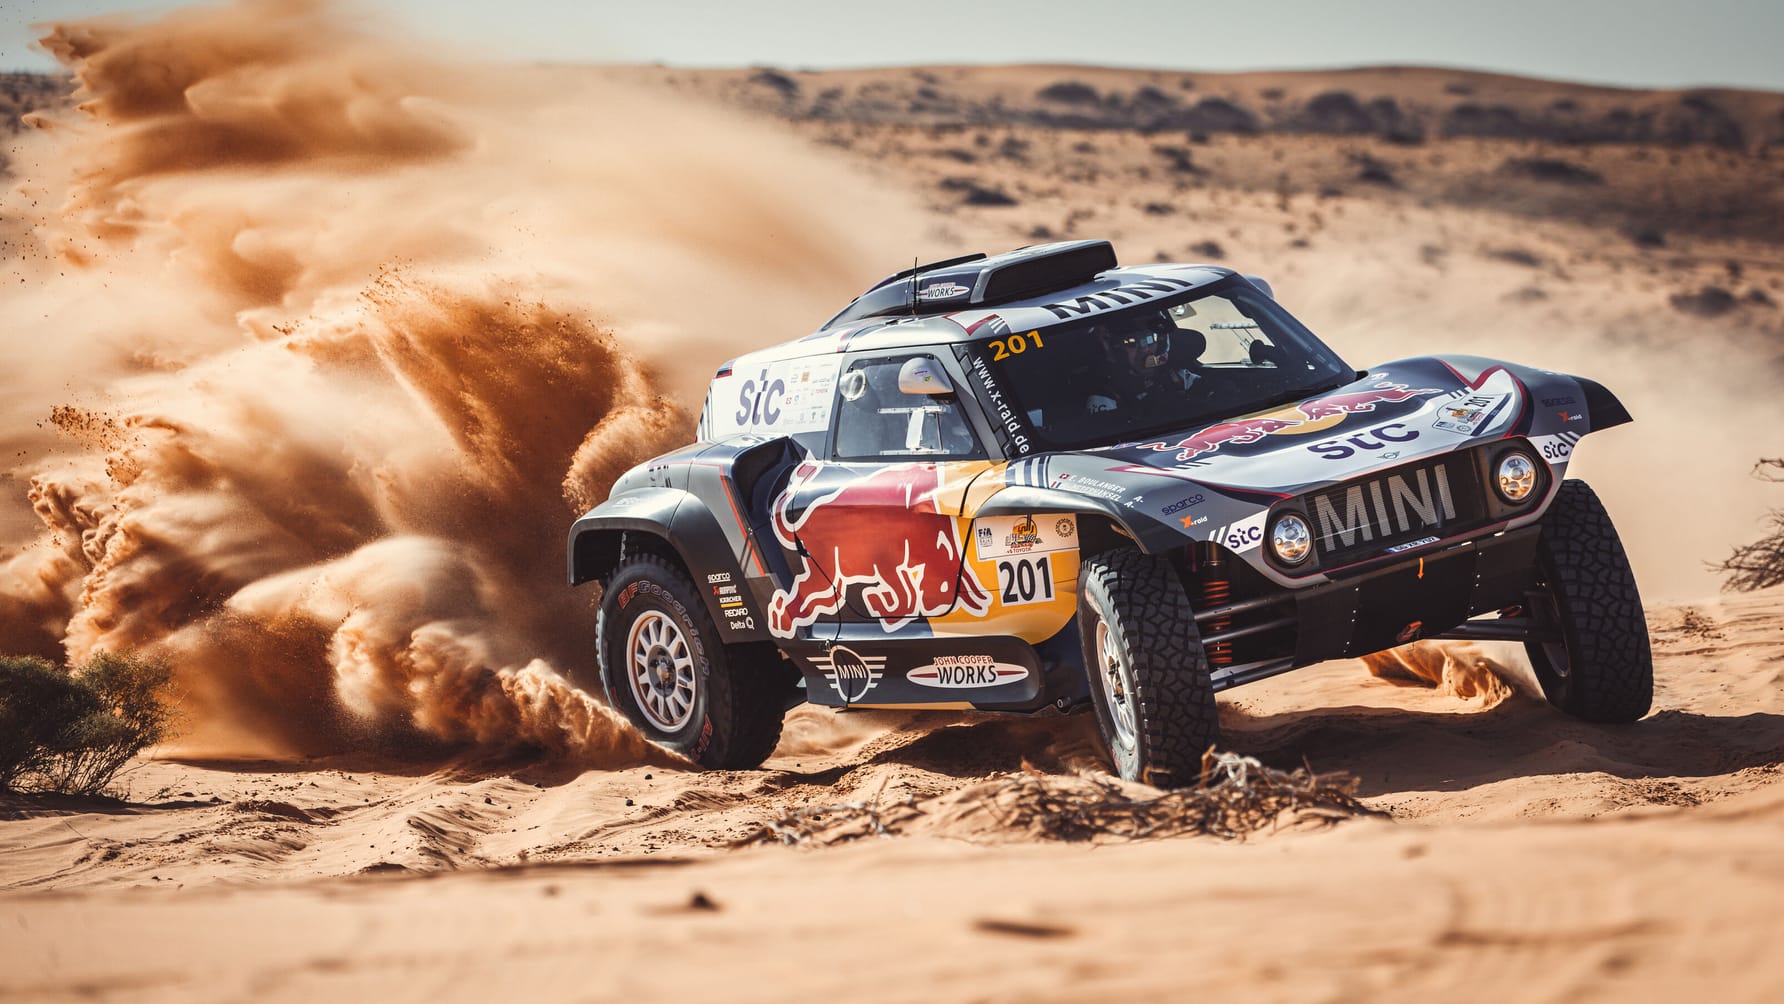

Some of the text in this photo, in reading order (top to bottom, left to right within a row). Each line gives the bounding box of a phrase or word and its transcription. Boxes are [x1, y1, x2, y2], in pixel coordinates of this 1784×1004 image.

[928, 287, 954, 297] WORKS
[1040, 277, 1193, 320] MINI
[988, 329, 1044, 362] 201
[973, 356, 1031, 454] www.x-raid.de
[1463, 395, 1497, 408] 201
[1306, 422, 1420, 460] stc
[1543, 441, 1569, 459] stc
[1078, 476, 1127, 494] BOULANGER
[1161, 493, 1206, 516] sparco
[1314, 463, 1456, 552] MINI
[1227, 526, 1262, 549] stc
[998, 556, 1052, 603] 201
[724, 607, 749, 618] RECARO
[933, 655, 994, 666] JOHN COOPER
[836, 664, 867, 680] MINI
[937, 664, 997, 685] WORKS
